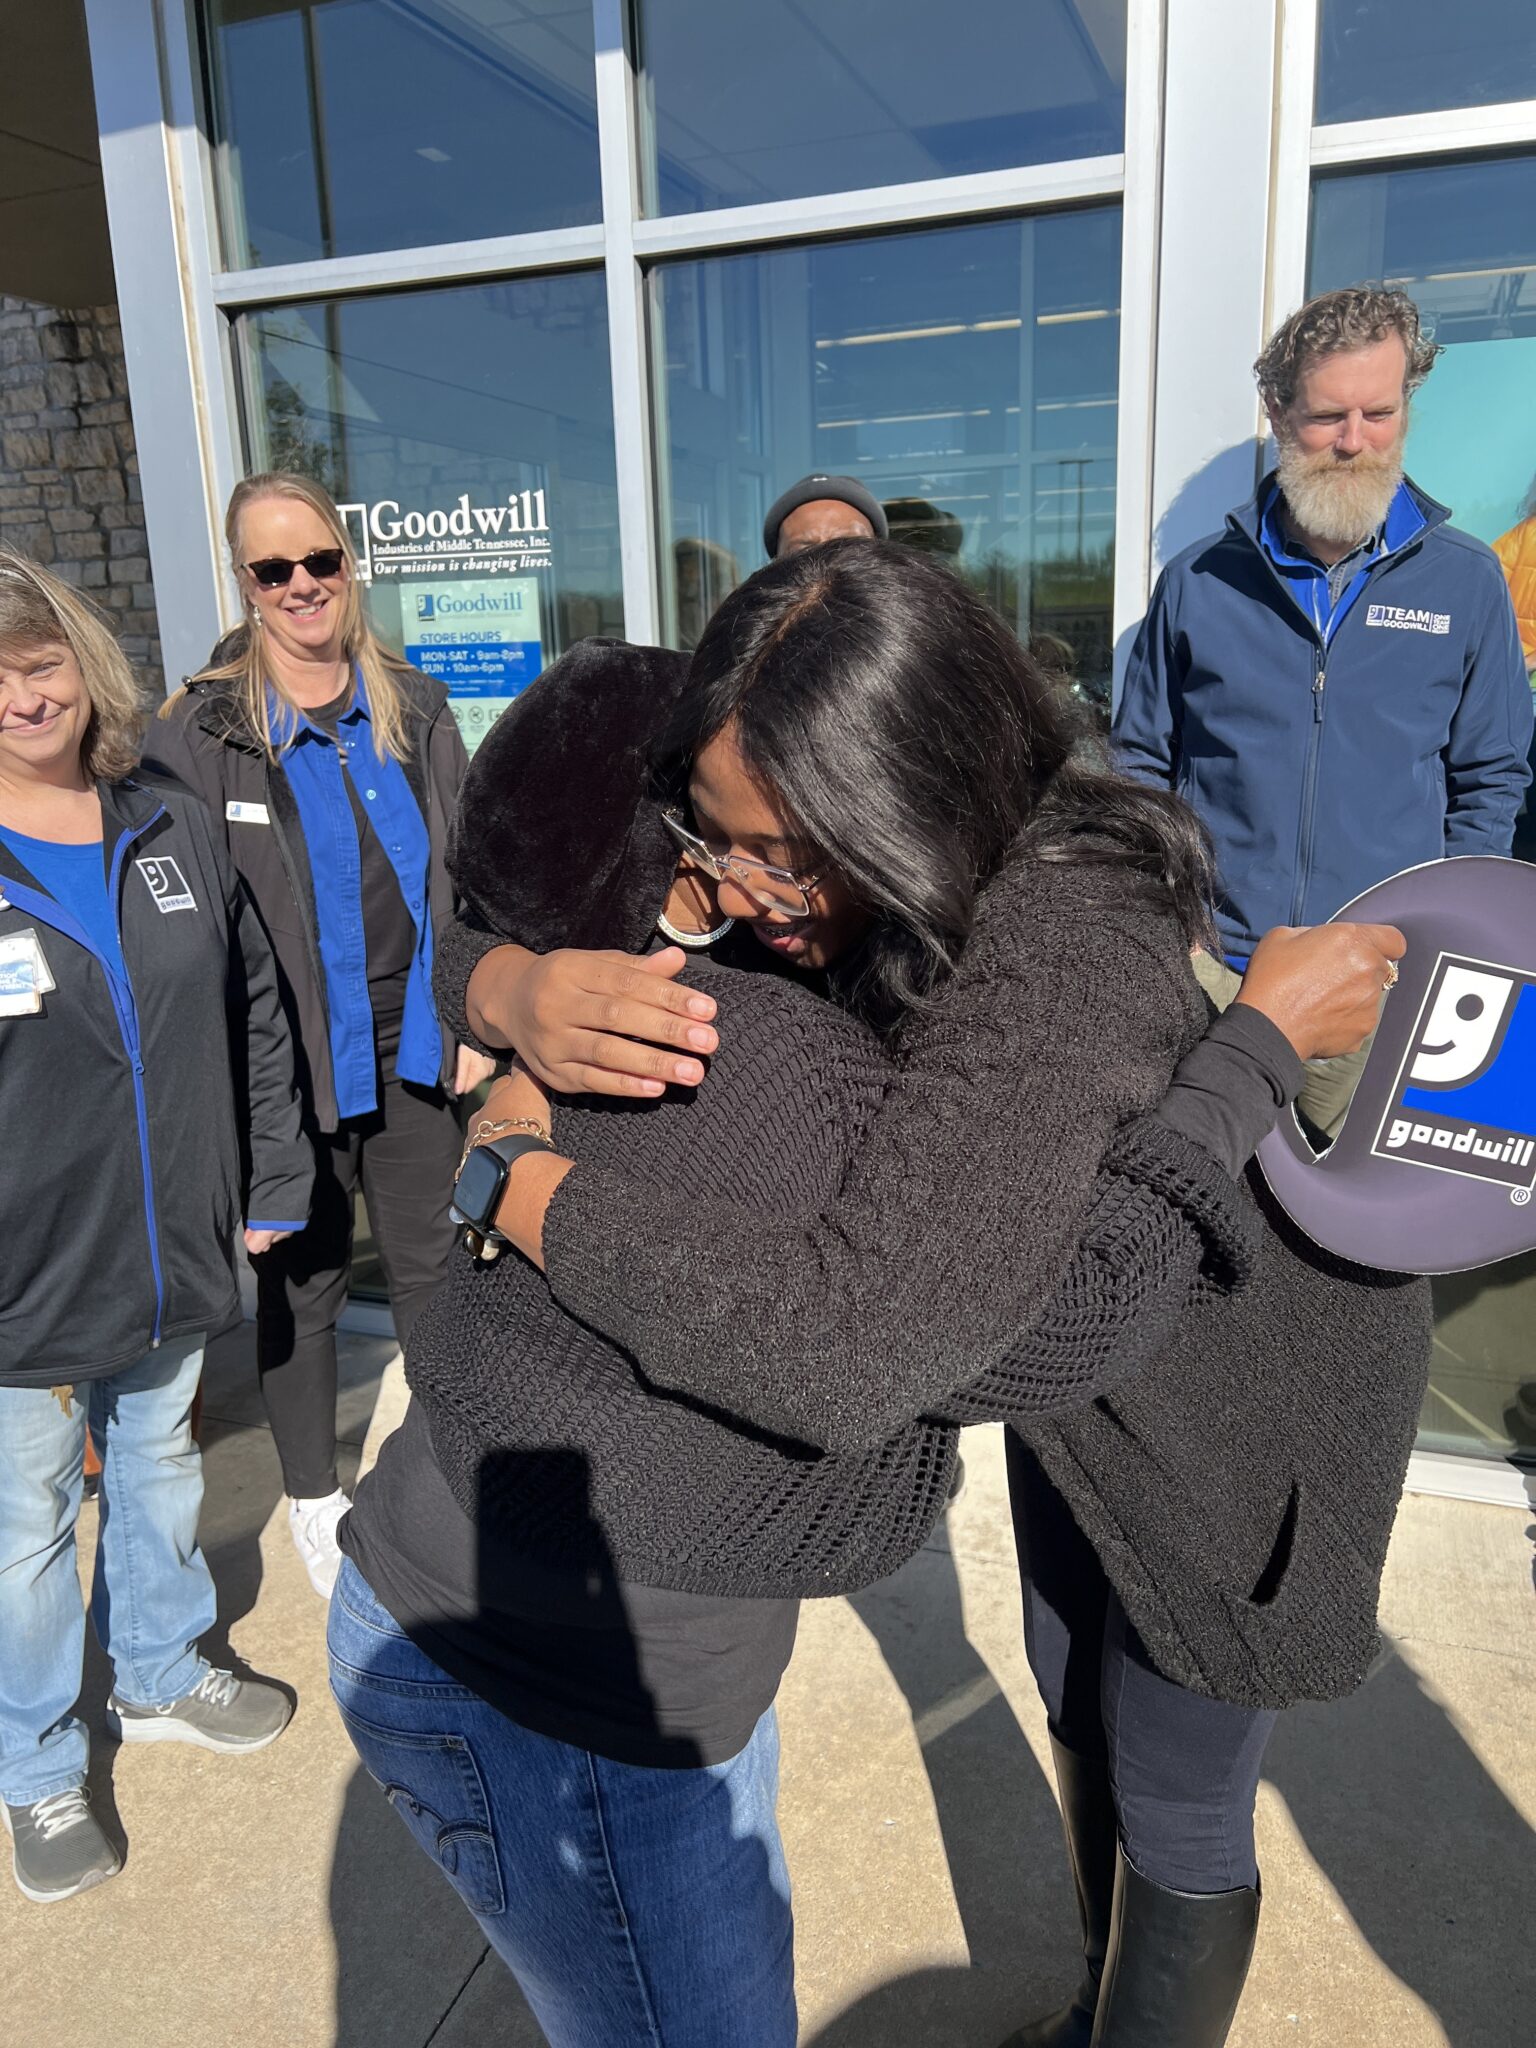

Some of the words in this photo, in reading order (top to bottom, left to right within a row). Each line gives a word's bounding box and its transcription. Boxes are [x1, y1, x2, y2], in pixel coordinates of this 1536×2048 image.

[370, 489, 549, 541] Goodwill
[372, 542, 423, 555] Industries
[423, 540, 436, 552] of
[436, 538, 472, 552] Middle
[472, 538, 528, 550] Tennessee,
[529, 535, 550, 547] Inc.
[374, 561, 398, 574] Our
[400, 560, 446, 573] mission
[448, 559, 460, 571] is
[462, 557, 517, 573] changing
[519, 554, 553, 568] lives.
[437, 592, 523, 613] Goodwill
[1386, 606, 1430, 624] TEAM
[1383, 619, 1429, 631] GOODWILL
[420, 632, 457, 644] STORE
[460, 631, 502, 642] HOURS
[421, 650, 468, 662] MON-SAT
[421, 663, 444, 673] SUN
[452, 662, 504, 674] 10am-6pm
[1386, 1119, 1535, 1167] goodwill
